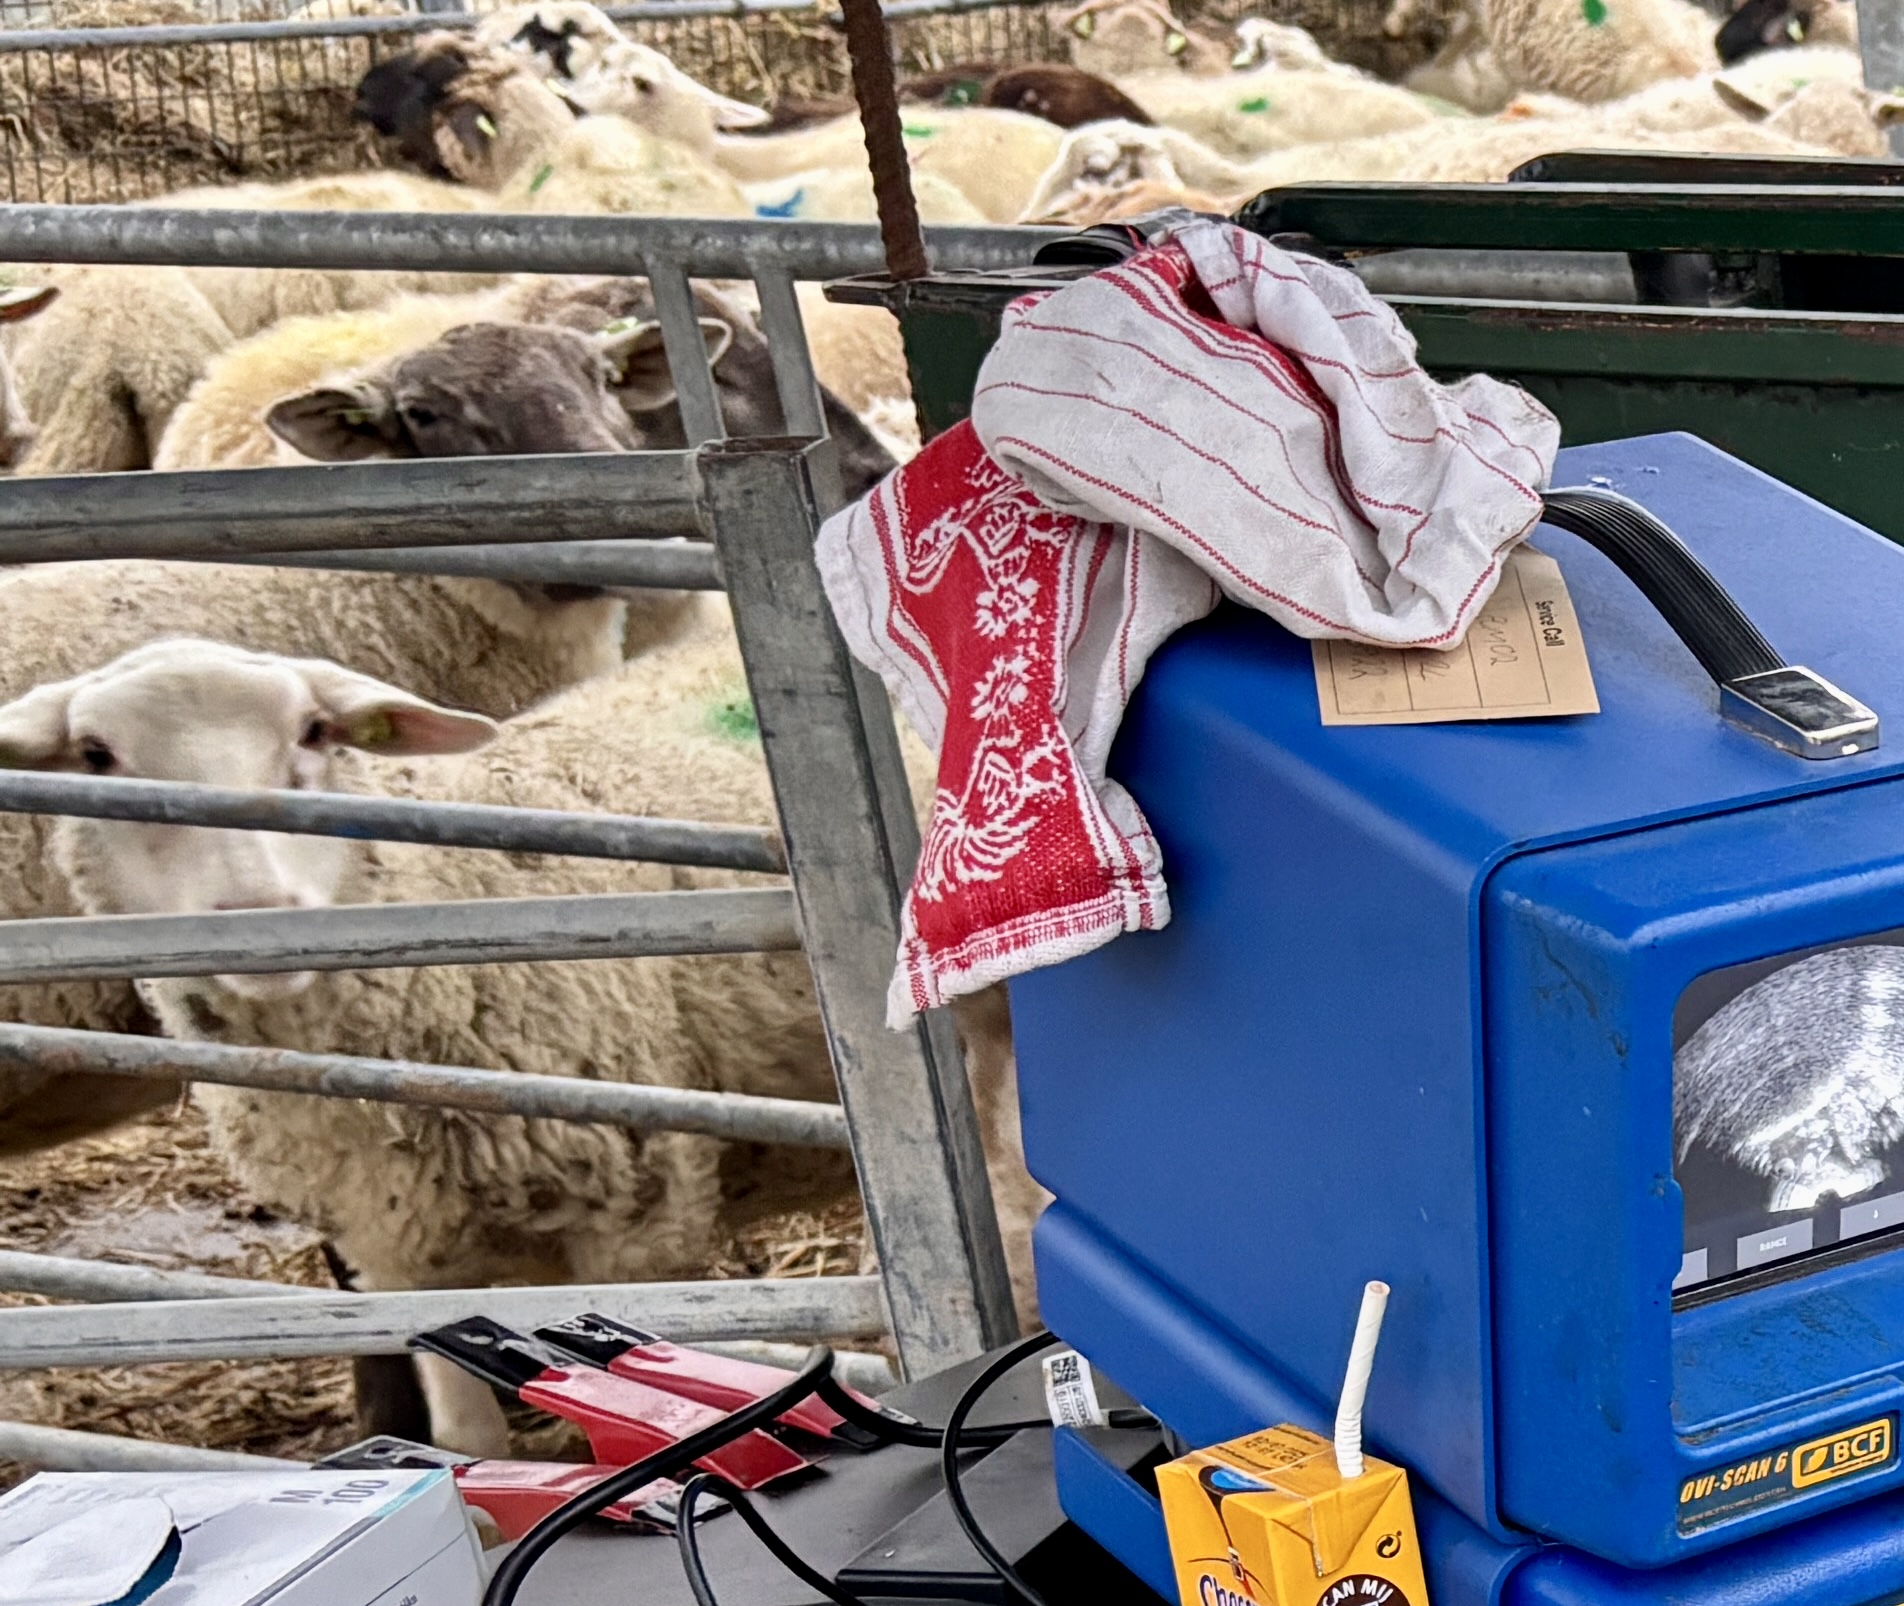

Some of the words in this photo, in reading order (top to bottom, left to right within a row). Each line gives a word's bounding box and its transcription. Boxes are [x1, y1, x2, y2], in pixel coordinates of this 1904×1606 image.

[1535, 600, 1555, 626] Service
[1542, 627, 1566, 647] Call
[1833, 1428, 1884, 1465] BCF
[1680, 1456, 1773, 1504] OVI-SCAN
[1774, 1451, 1789, 1474] 6
[320, 1479, 390, 1506] 100
[1360, 1578, 1394, 1604] MIJ
